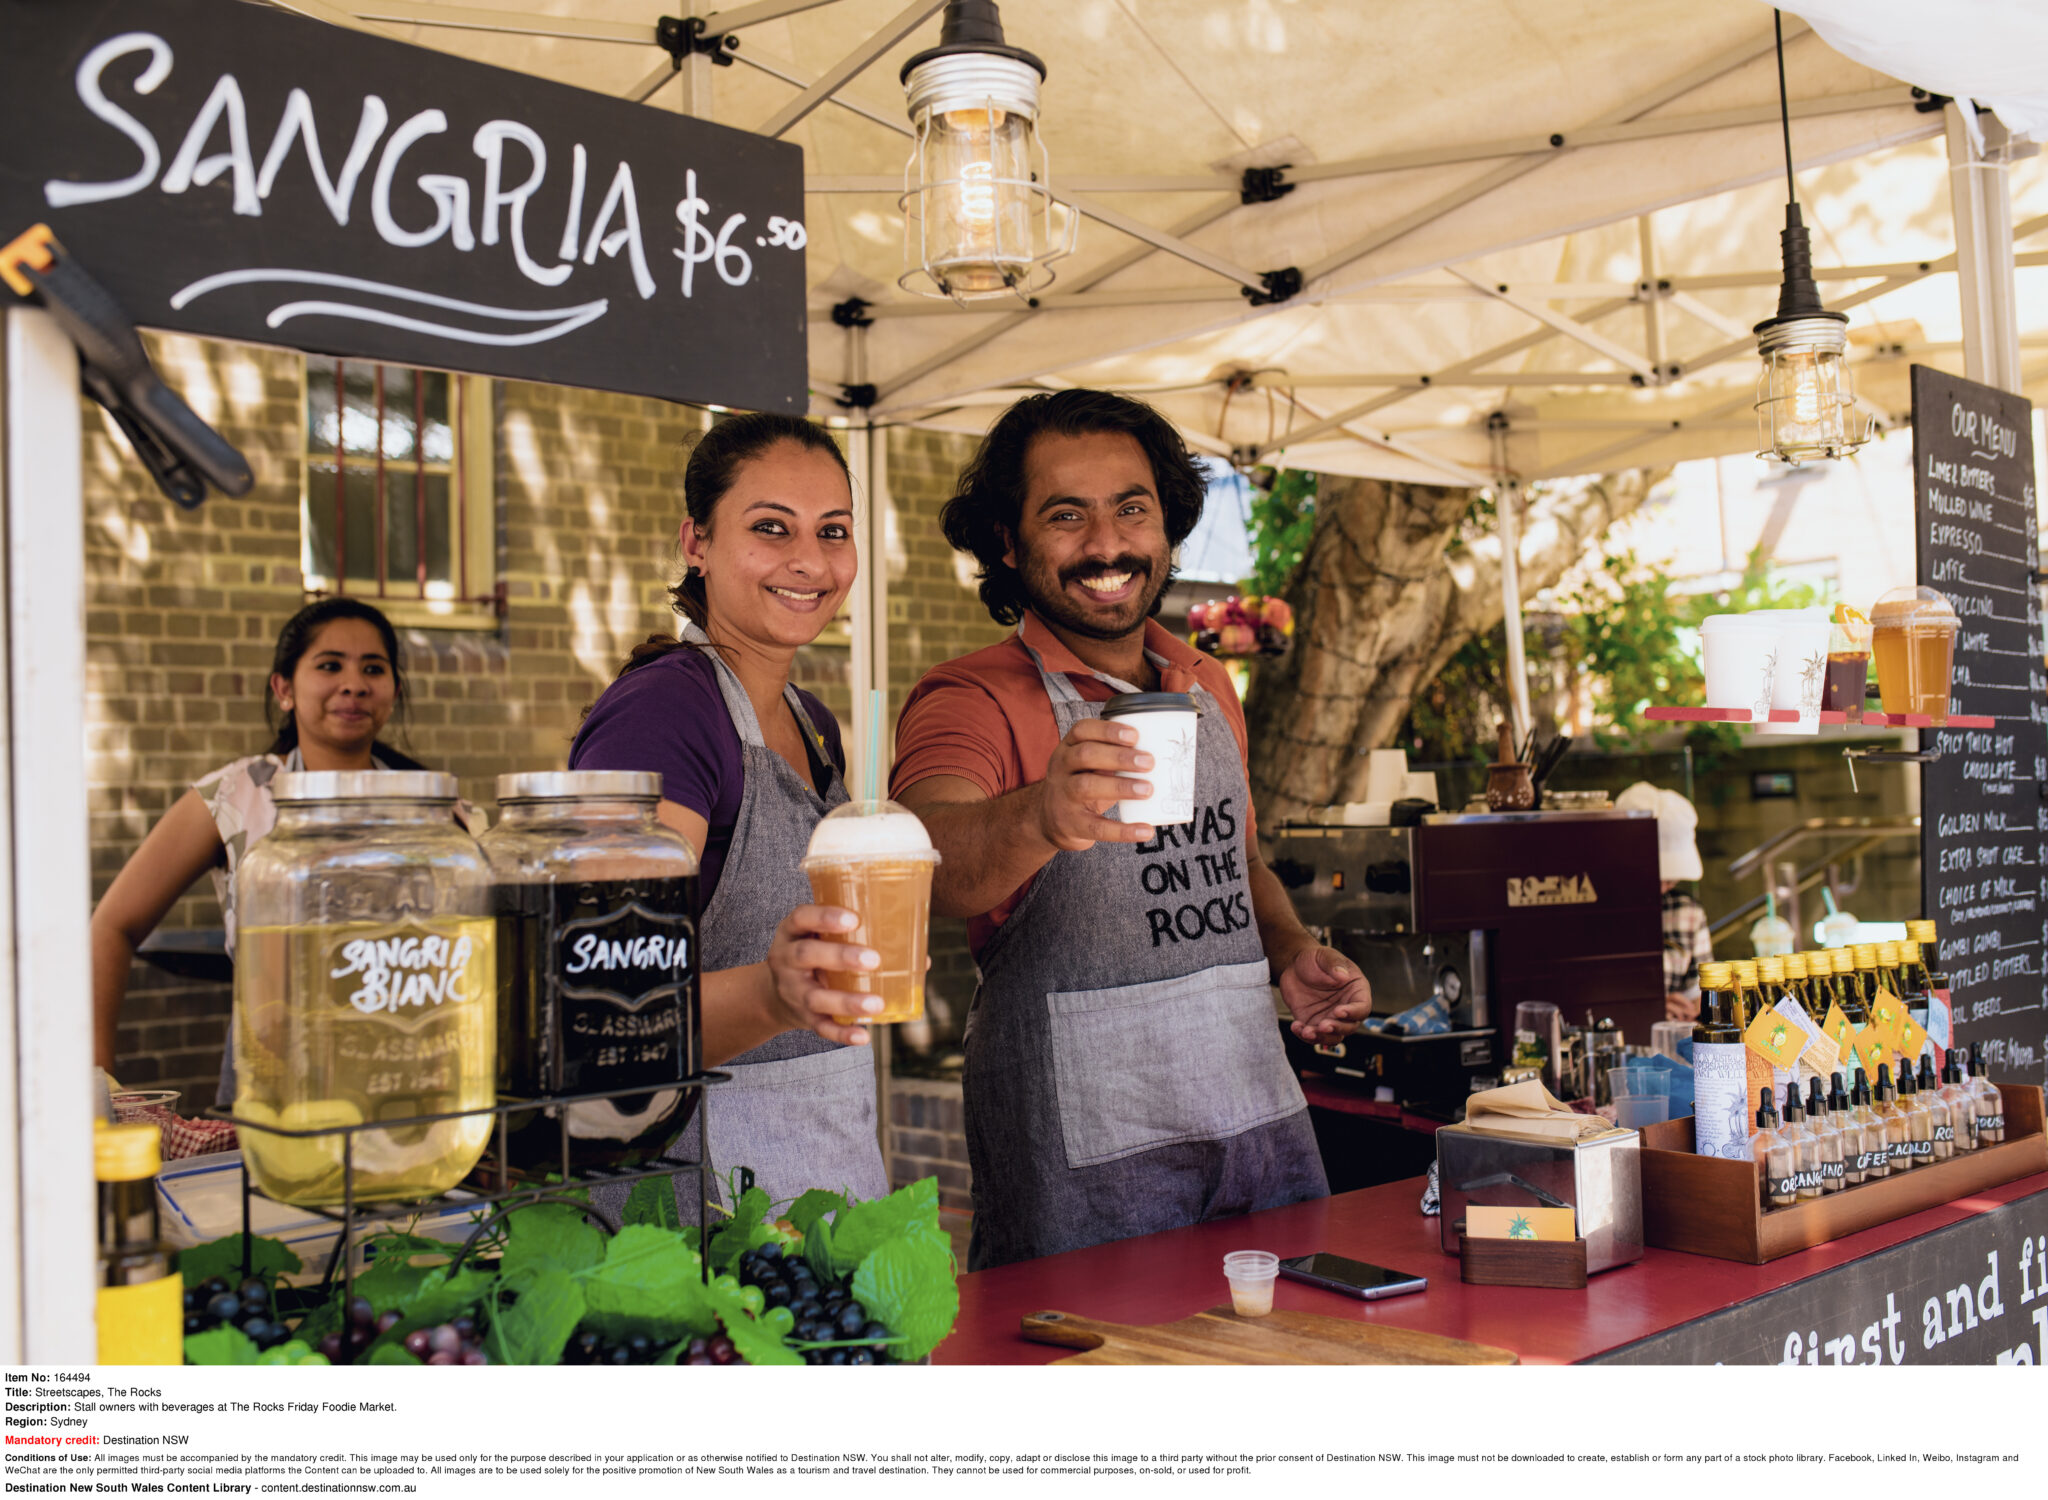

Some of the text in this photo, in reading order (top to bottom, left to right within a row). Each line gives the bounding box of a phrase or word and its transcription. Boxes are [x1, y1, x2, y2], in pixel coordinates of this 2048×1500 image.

[45, 32, 656, 299] SANGRIA
[1928, 488, 1967, 517] MULLED
[1968, 500, 1993, 522] WINE
[1930, 522, 1983, 555] EXPRESSO
[1951, 665, 1971, 687] CHA
[1936, 730, 1964, 755] SPICY
[1995, 735, 2015, 756] HOT
[1963, 760, 2016, 780] CHOCOLATE
[1938, 809, 2007, 838] GOLDEN MILK
[1141, 846, 1241, 895] ON THE
[1939, 847, 1973, 872] EXTRA
[1939, 884, 1975, 909] CHOICE
[1980, 879, 1992, 900] OF
[1145, 891, 1250, 948] ROCKS
[330, 935, 473, 979] SANGRIA
[566, 933, 687, 974] SANGRIA
[1992, 953, 2031, 981] BITTERS
[1952, 997, 2002, 1025] SIL SEEDS
[1922, 1249, 2004, 1350] and
